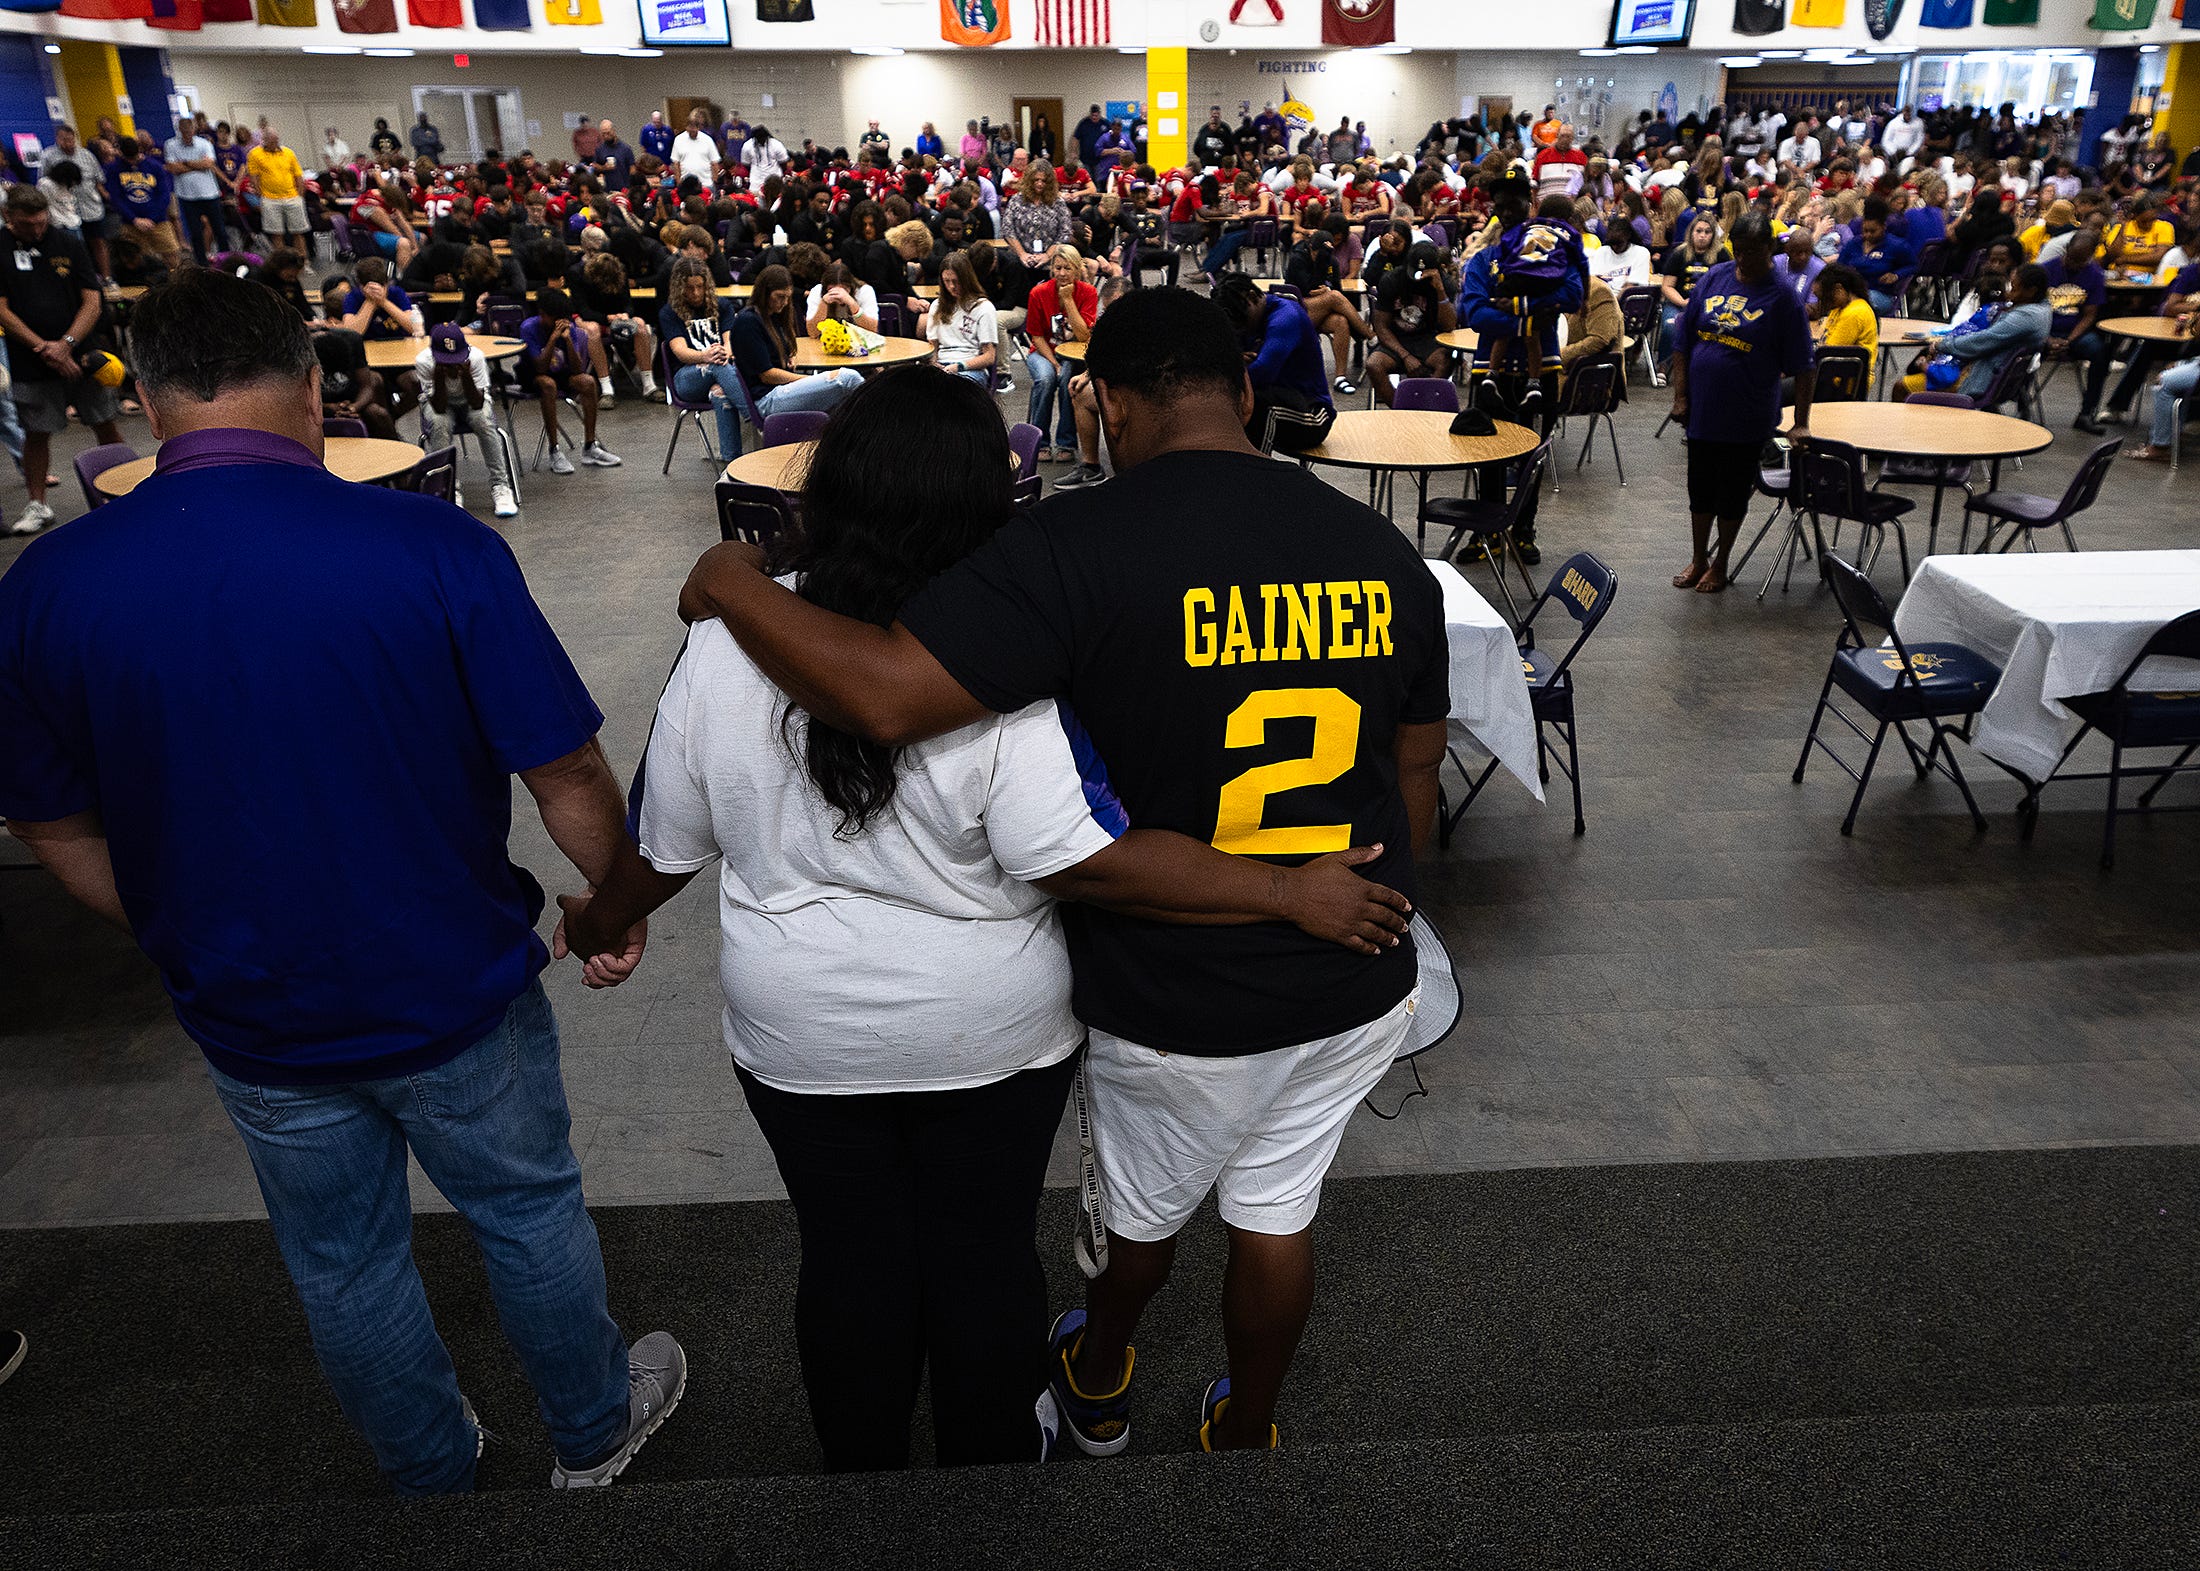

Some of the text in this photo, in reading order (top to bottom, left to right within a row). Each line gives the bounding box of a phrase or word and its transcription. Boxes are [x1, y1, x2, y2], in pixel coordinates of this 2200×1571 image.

[1259, 61, 1327, 73] FIGHTING
[1184, 581, 1394, 667] GAINER
[1211, 688, 1361, 855] 2
[1077, 1098, 1090, 1139] VANDERBILT
[1085, 1163, 1098, 1195] FOOTBALL
[1090, 1199, 1104, 1239] VANDERBILT
